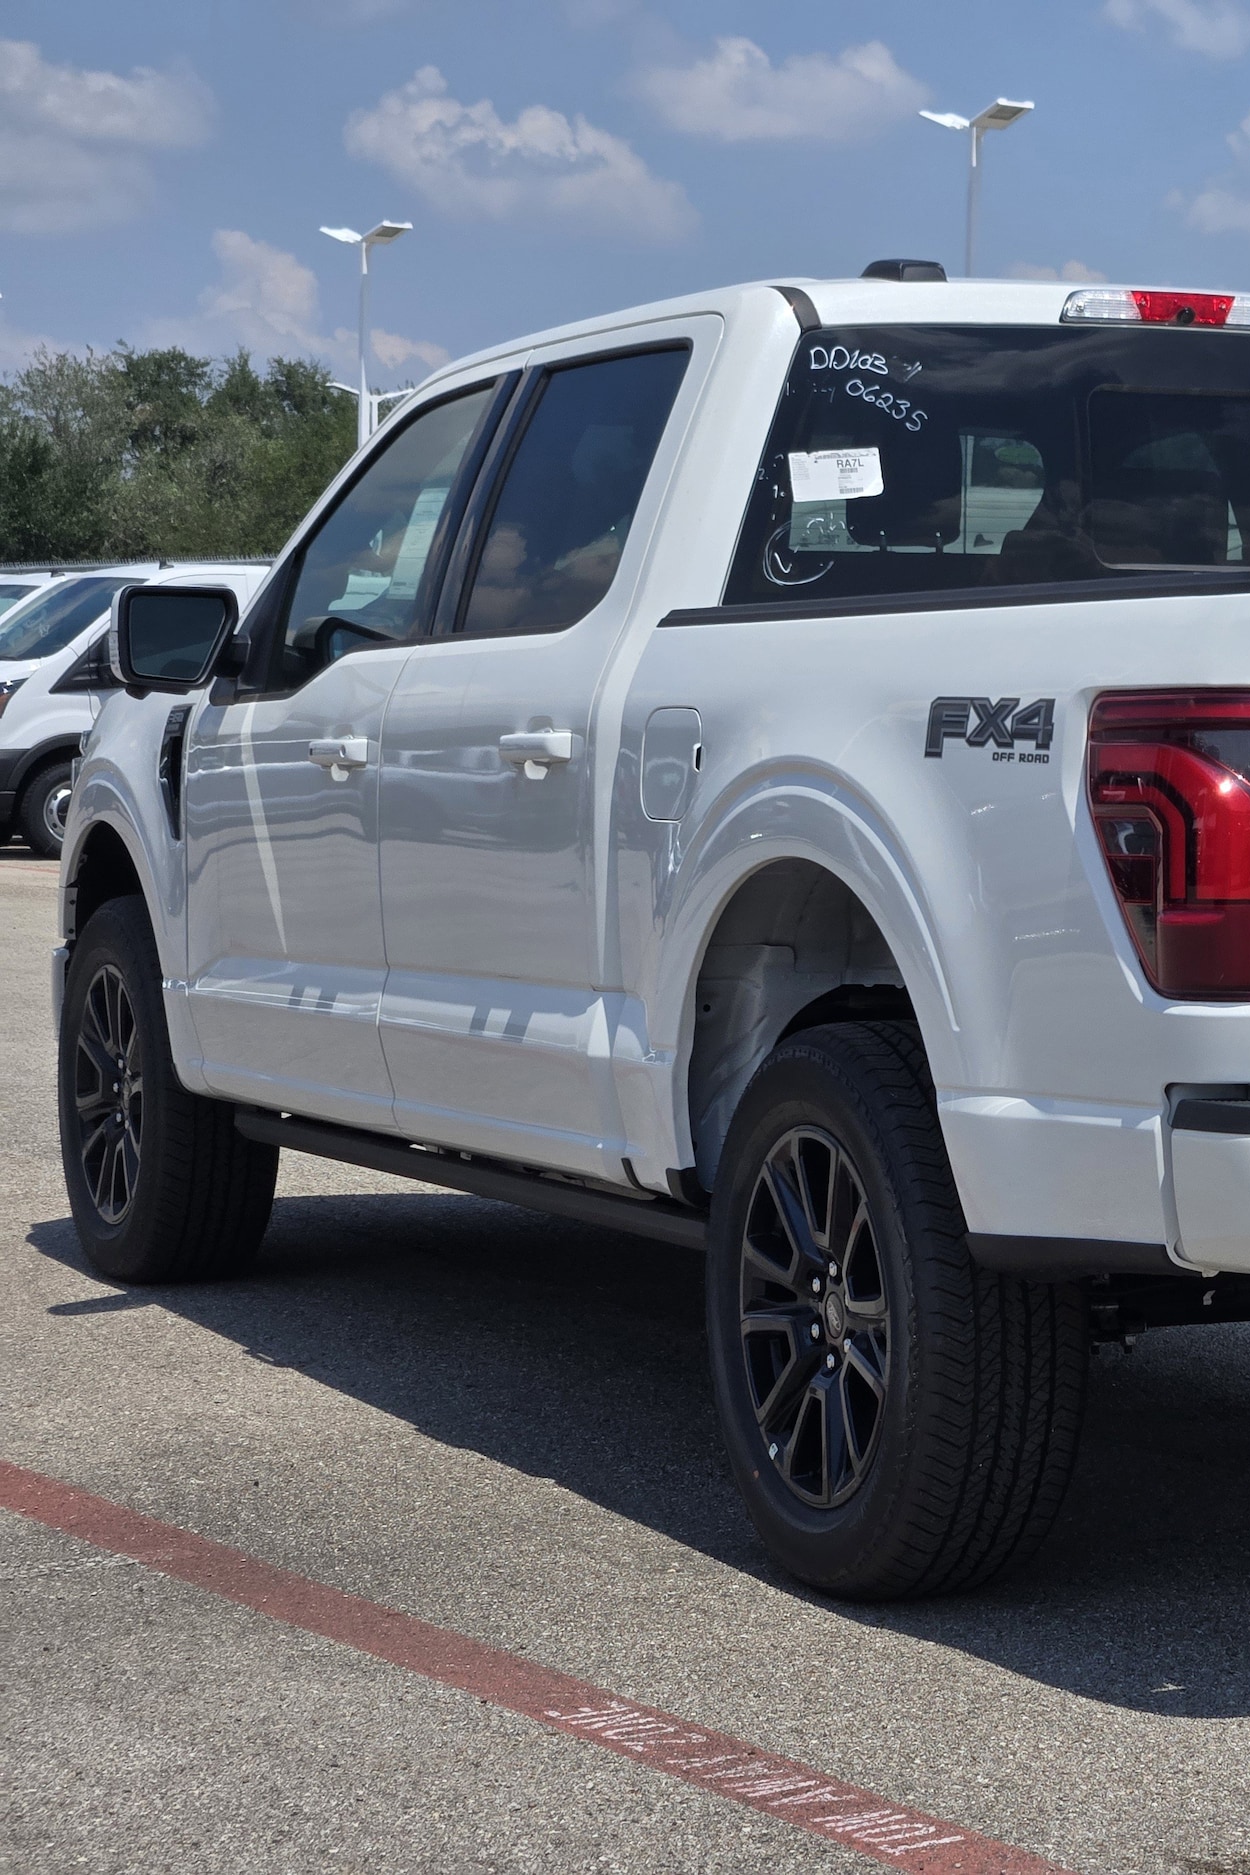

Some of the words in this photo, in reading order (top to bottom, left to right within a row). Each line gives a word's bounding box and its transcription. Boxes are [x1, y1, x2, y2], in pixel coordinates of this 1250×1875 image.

[846, 379, 929, 432] 06235
[836, 458, 864, 469] RA7L
[924, 696, 1056, 759] FX4
[992, 752, 1015, 762] OFF
[1018, 753, 1050, 764] ROAD
[810, 1809, 966, 1857] TOW
